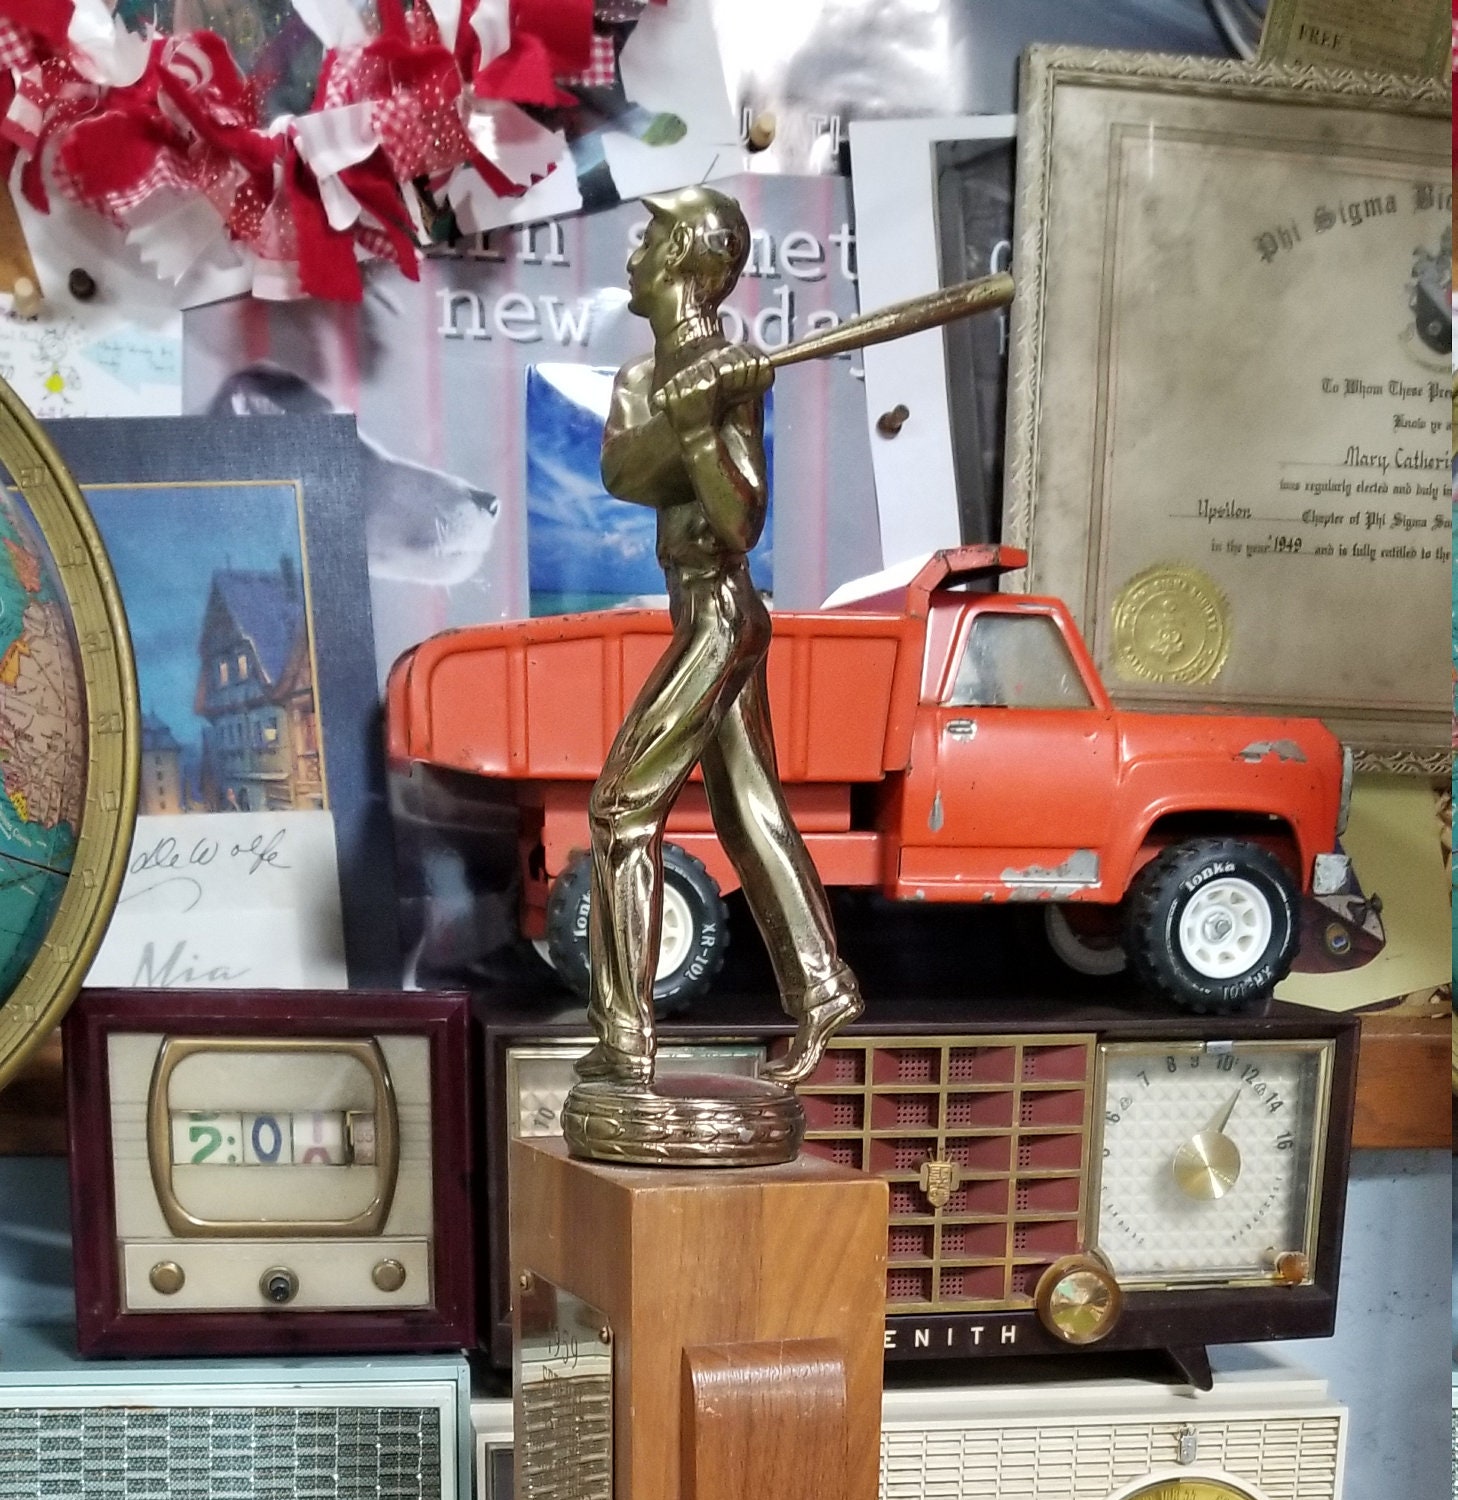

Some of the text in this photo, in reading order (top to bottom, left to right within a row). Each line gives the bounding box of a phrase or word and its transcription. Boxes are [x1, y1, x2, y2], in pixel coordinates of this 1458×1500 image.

[1313, 193, 1398, 233] Sigma
[436, 286, 594, 345] new
[1321, 377, 1339, 395] To
[1344, 378, 1383, 399] Whom
[1389, 380, 1423, 400] These
[1344, 446, 1452, 475] Mary Catheri
[1305, 480, 1351, 497] regularly
[1356, 481, 1389, 495] elected
[1393, 483, 1412, 496] and
[1416, 483, 1438, 500] duly
[1199, 499, 1252, 524] Upsilon
[1302, 510, 1344, 526] Chapter
[1350, 511, 1361, 526] of
[1365, 511, 1386, 530] Phi
[1390, 511, 1427, 531] Sigma
[1226, 539, 1243, 554] the
[1273, 535, 1302, 553] 1949
[1315, 542, 1334, 556] and
[1338, 543, 1347, 557] is
[1352, 542, 1376, 562] fully
[1381, 544, 1417, 559] entitled
[1421, 546, 1431, 560] to
[1436, 546, 1449, 563] the
[133, 939, 250, 987] Mia
[1137, 1070, 1151, 1088] 7
[1241, 1064, 1260, 1086] 12
[1265, 1092, 1285, 1114] 14
[1276, 1131, 1294, 1151] 16
[884, 1324, 1017, 1349] ENITH
